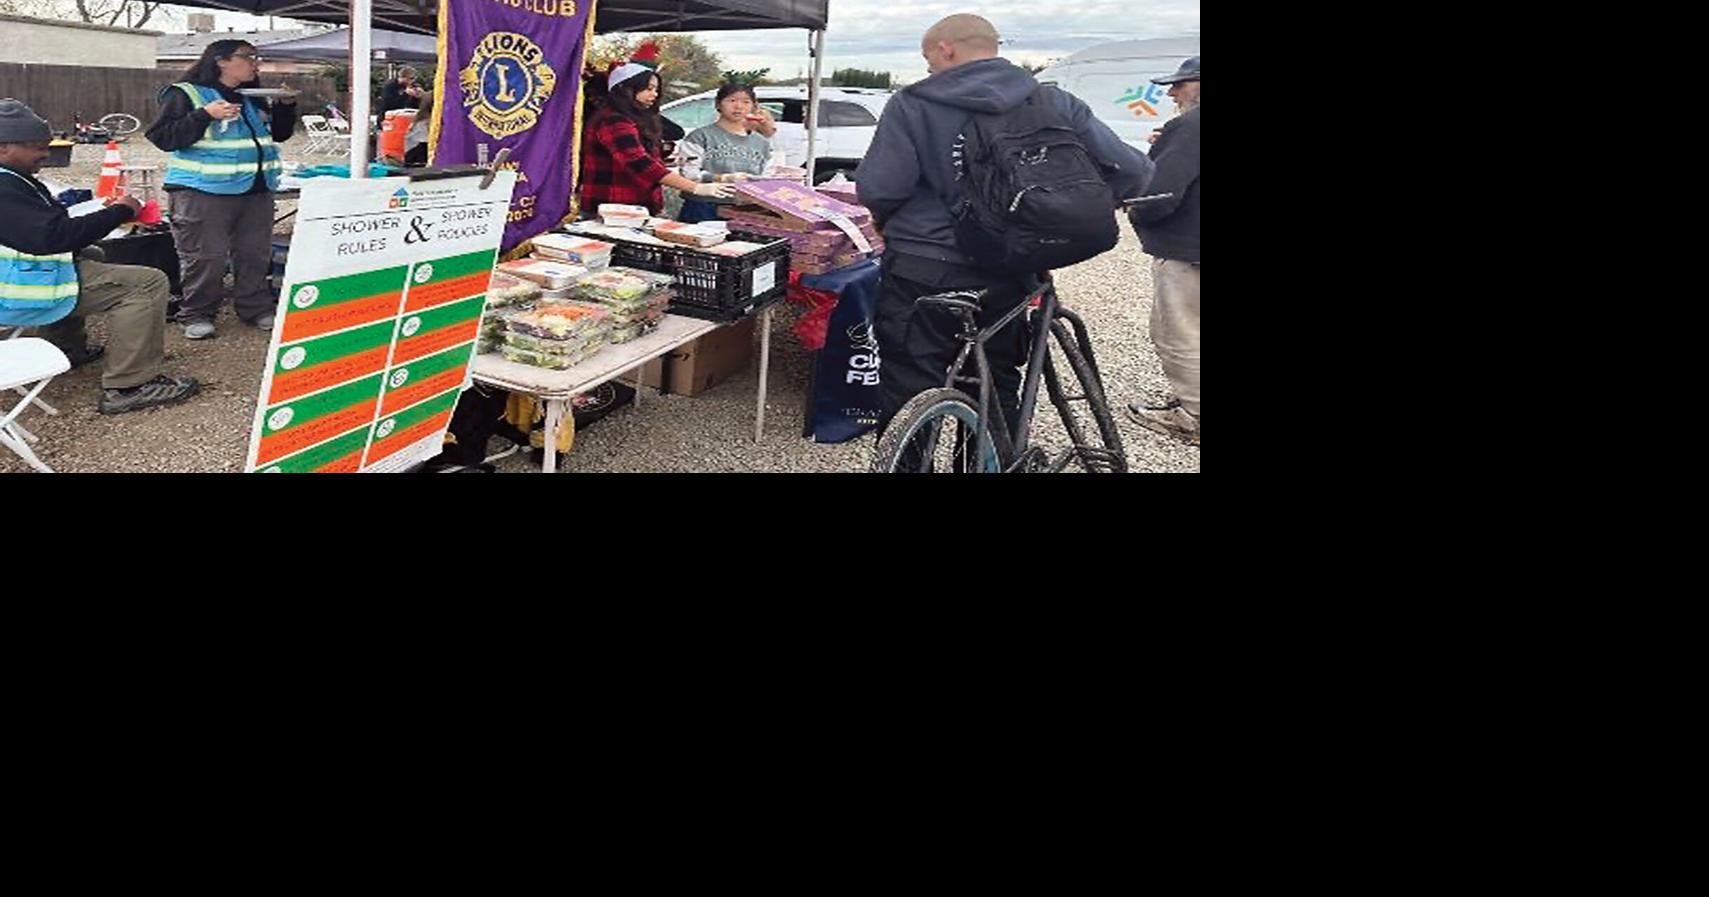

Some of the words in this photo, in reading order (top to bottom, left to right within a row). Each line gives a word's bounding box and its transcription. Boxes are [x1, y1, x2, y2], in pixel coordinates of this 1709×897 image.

[524, 0, 576, 16] CLUB
[484, 35, 539, 62] LIONS
[496, 63, 516, 102] L
[441, 207, 493, 223] SHOWER
[331, 217, 400, 236] SHOWER
[404, 216, 435, 244] &
[337, 238, 387, 256] RULES
